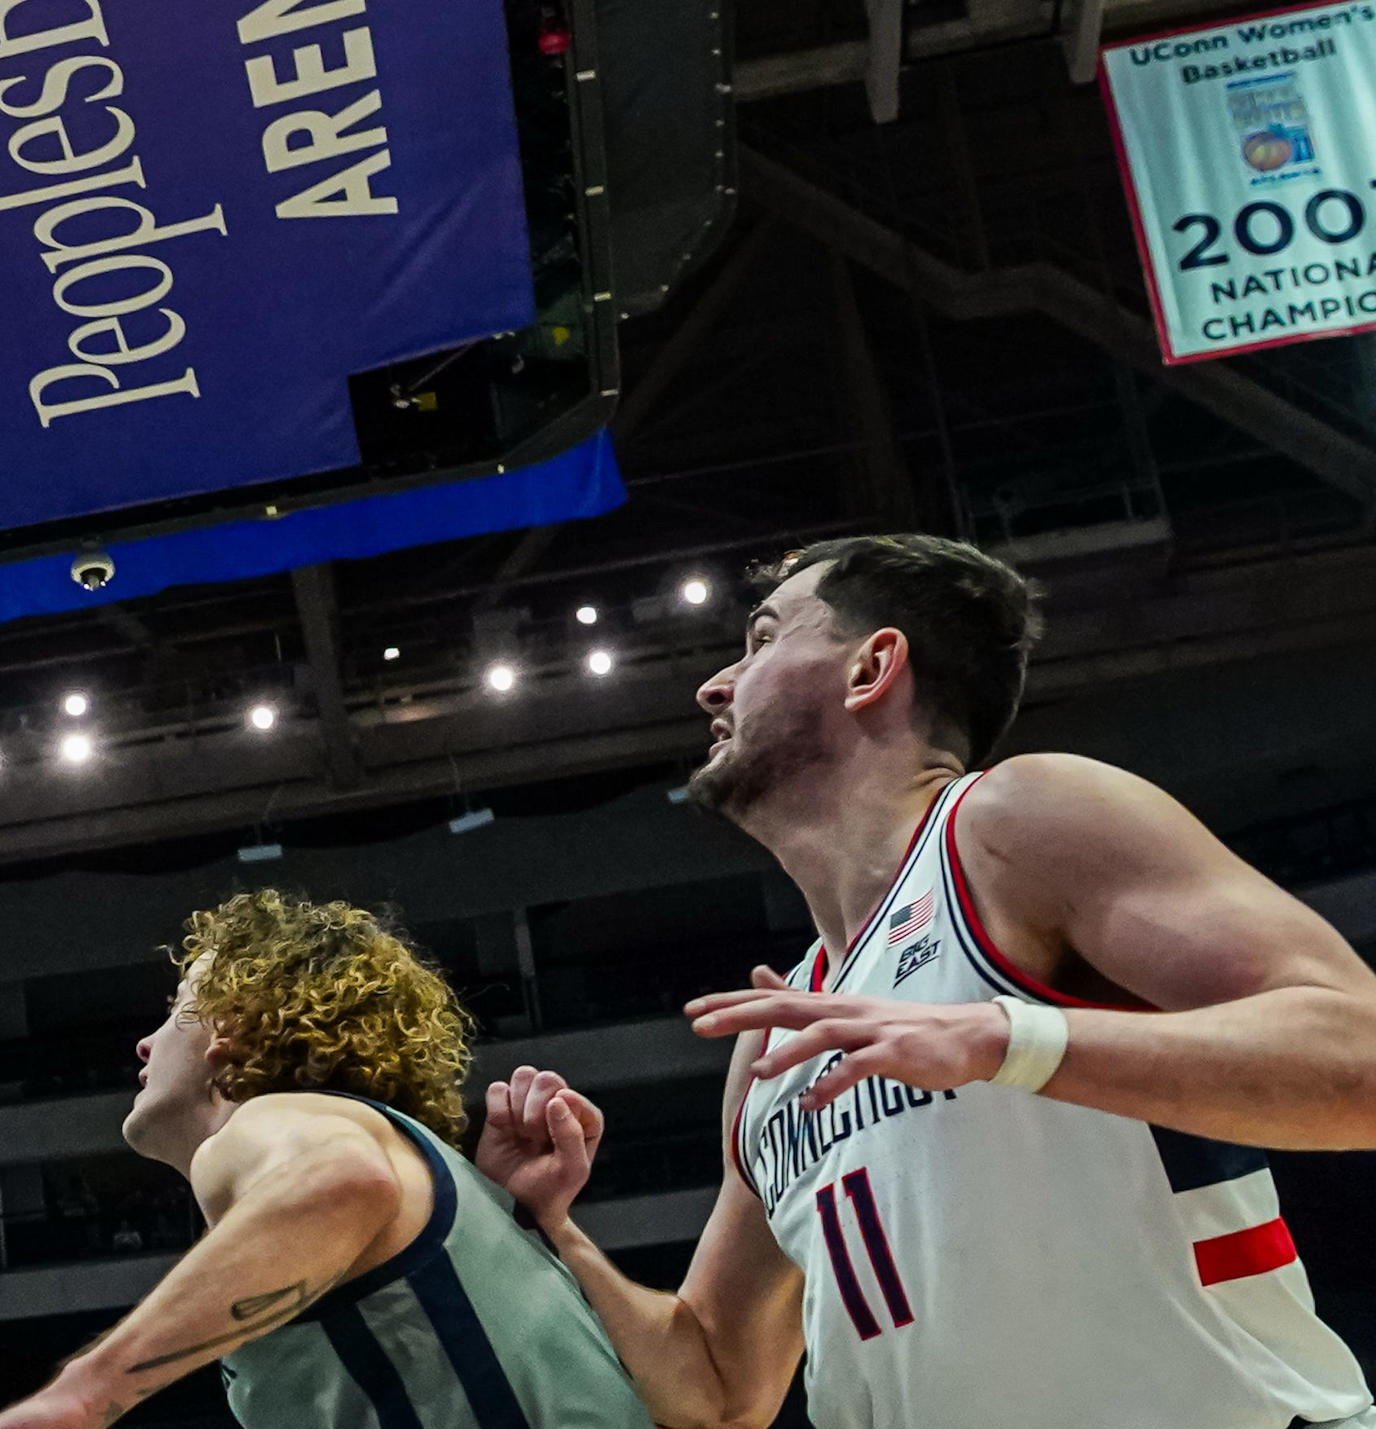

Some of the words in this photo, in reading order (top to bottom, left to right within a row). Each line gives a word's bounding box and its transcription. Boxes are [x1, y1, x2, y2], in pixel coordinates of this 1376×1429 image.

[1130, 34, 1228, 66] UConn
[1237, 5, 1375, 44] Women's
[1181, 38, 1338, 86] Basketball
[236, 0, 399, 219] AREN
[1210, 250, 1376, 304] NATION
[1202, 290, 1376, 341] CHAMPIO
[895, 940, 942, 978] EAST
[899, 934, 931, 962] BIG
[815, 1166, 915, 1342] 11
